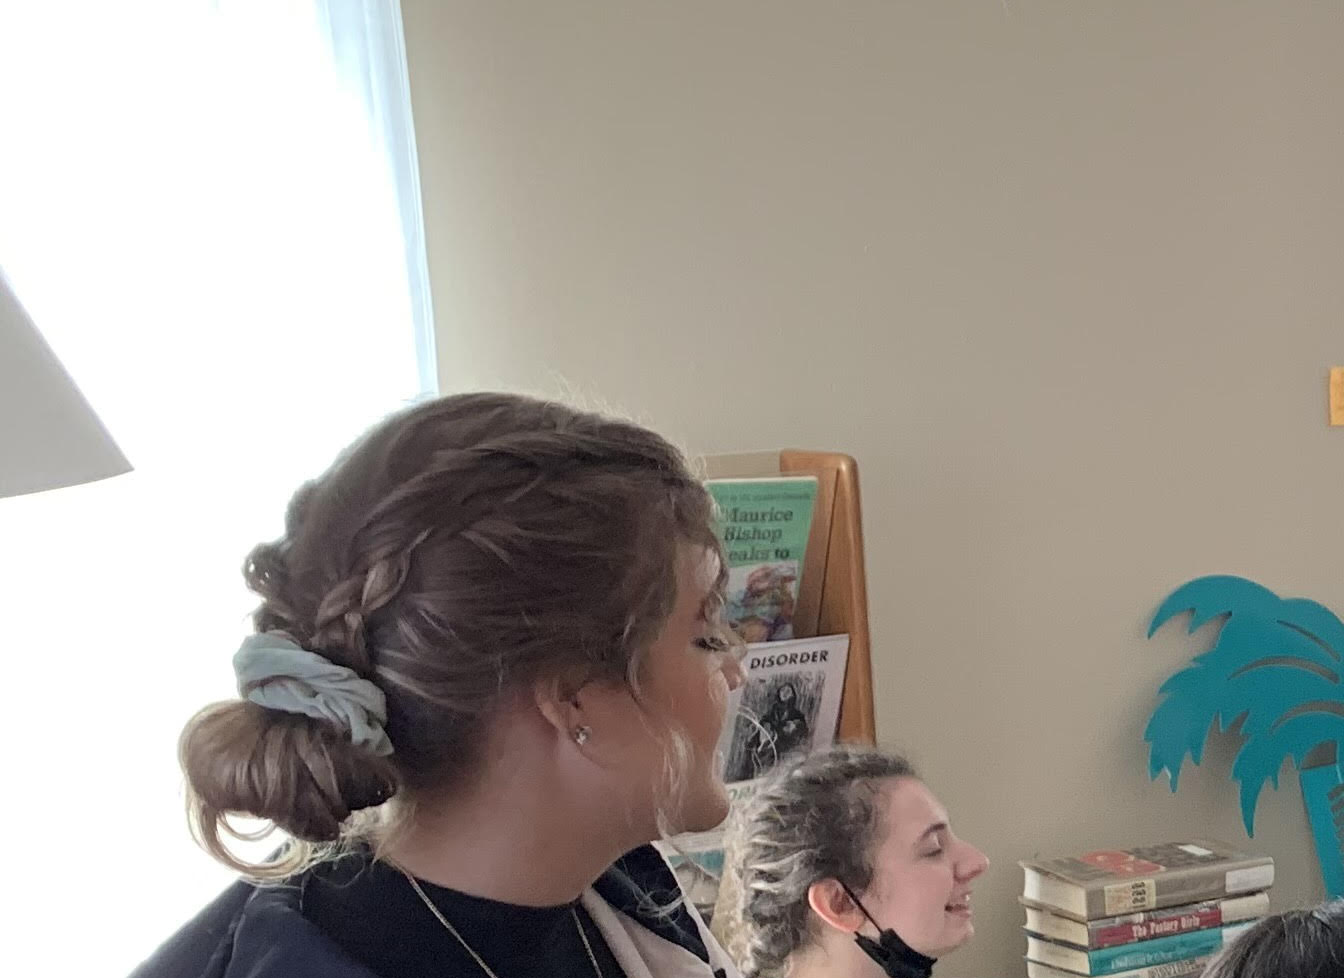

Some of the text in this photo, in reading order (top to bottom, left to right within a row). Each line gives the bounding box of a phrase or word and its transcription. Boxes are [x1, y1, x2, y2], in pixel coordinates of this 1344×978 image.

[724, 526, 783, 544] Bishop
[728, 545, 790, 561] eaks to
[750, 650, 829, 670] DISORDER
